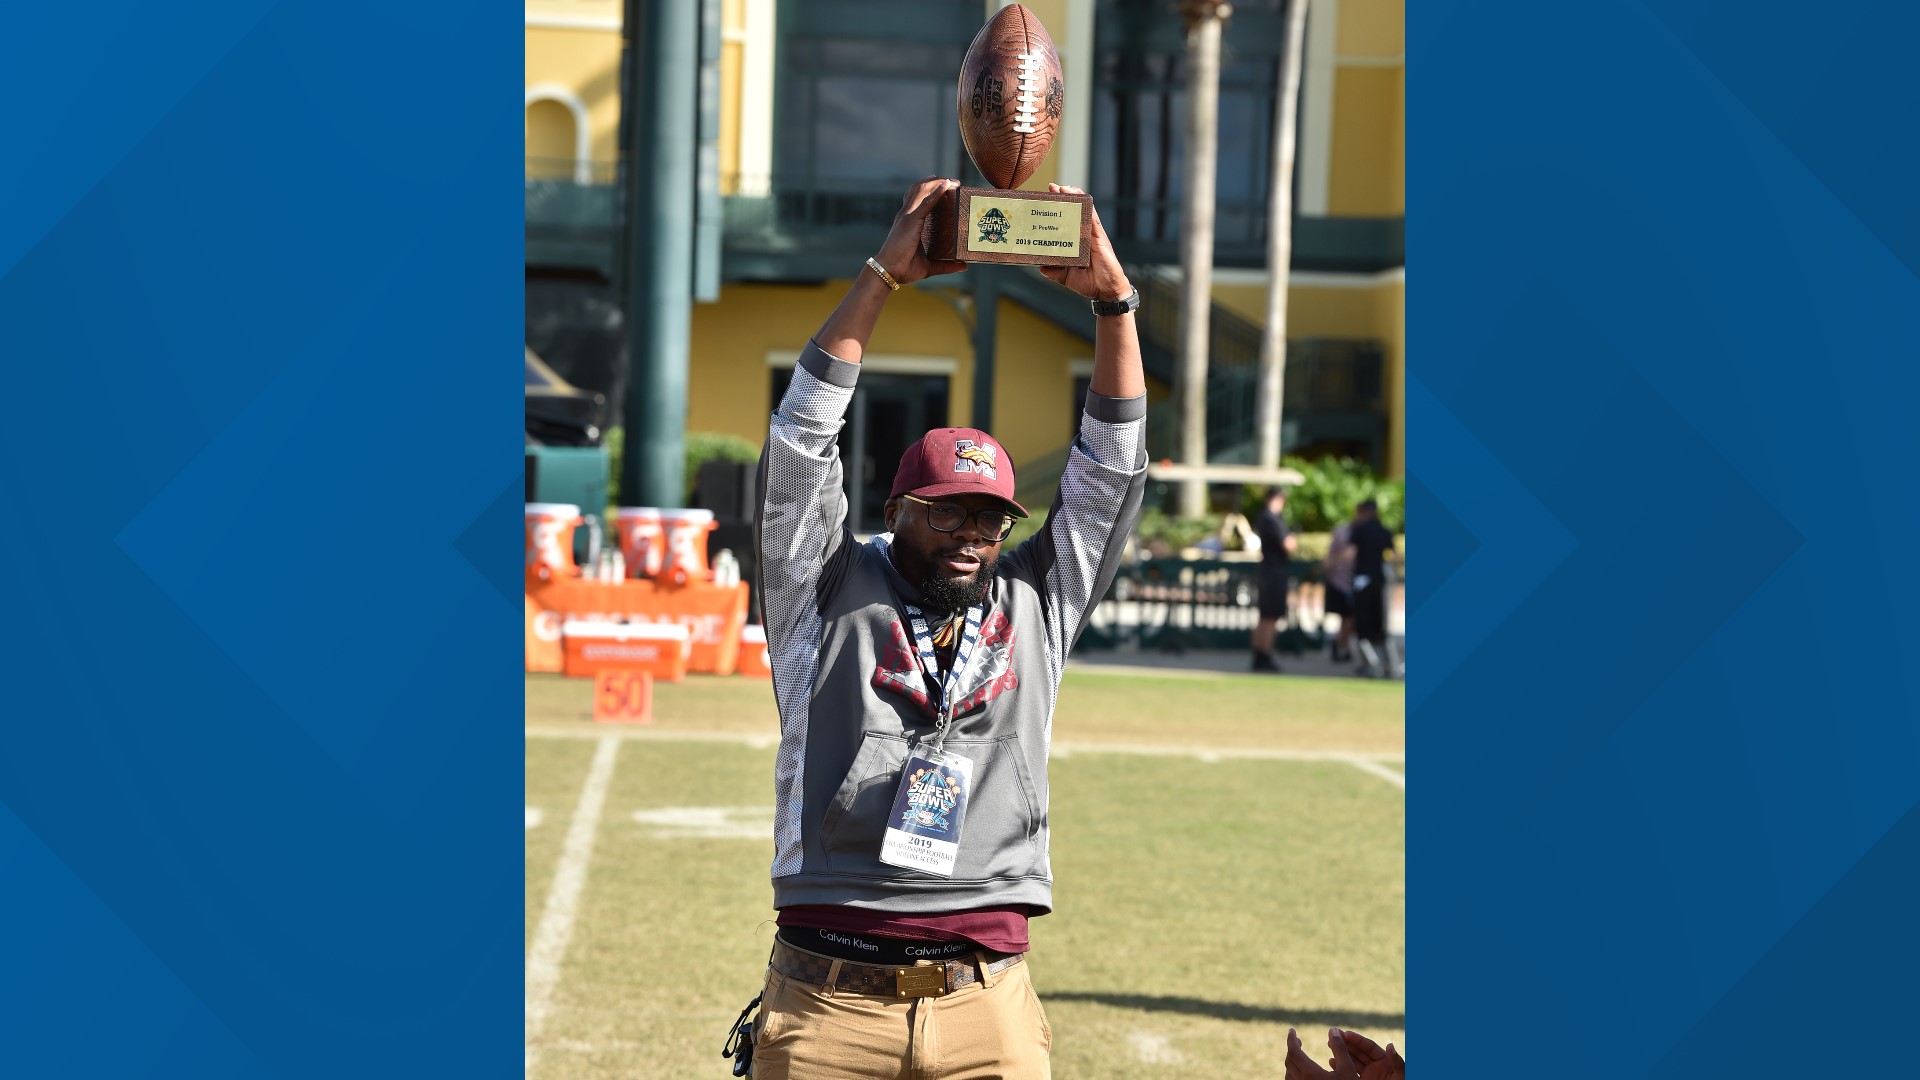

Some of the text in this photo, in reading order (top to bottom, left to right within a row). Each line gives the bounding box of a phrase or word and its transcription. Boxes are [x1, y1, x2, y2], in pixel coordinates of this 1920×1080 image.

[1031, 209, 1058, 217] Division
[979, 216, 1009, 226] SUPER
[981, 223, 1006, 233] BOWL
[1016, 238, 1074, 248] 2019 CHAMPION
[954, 439, 997, 481] M
[601, 672, 645, 716] 50
[908, 781, 954, 804] SUPER
[909, 792, 950, 813] BOWL
[907, 835, 932, 849] 2019
[819, 928, 879, 952] Calvin Klein
[905, 943, 967, 956] Calvin Klein
